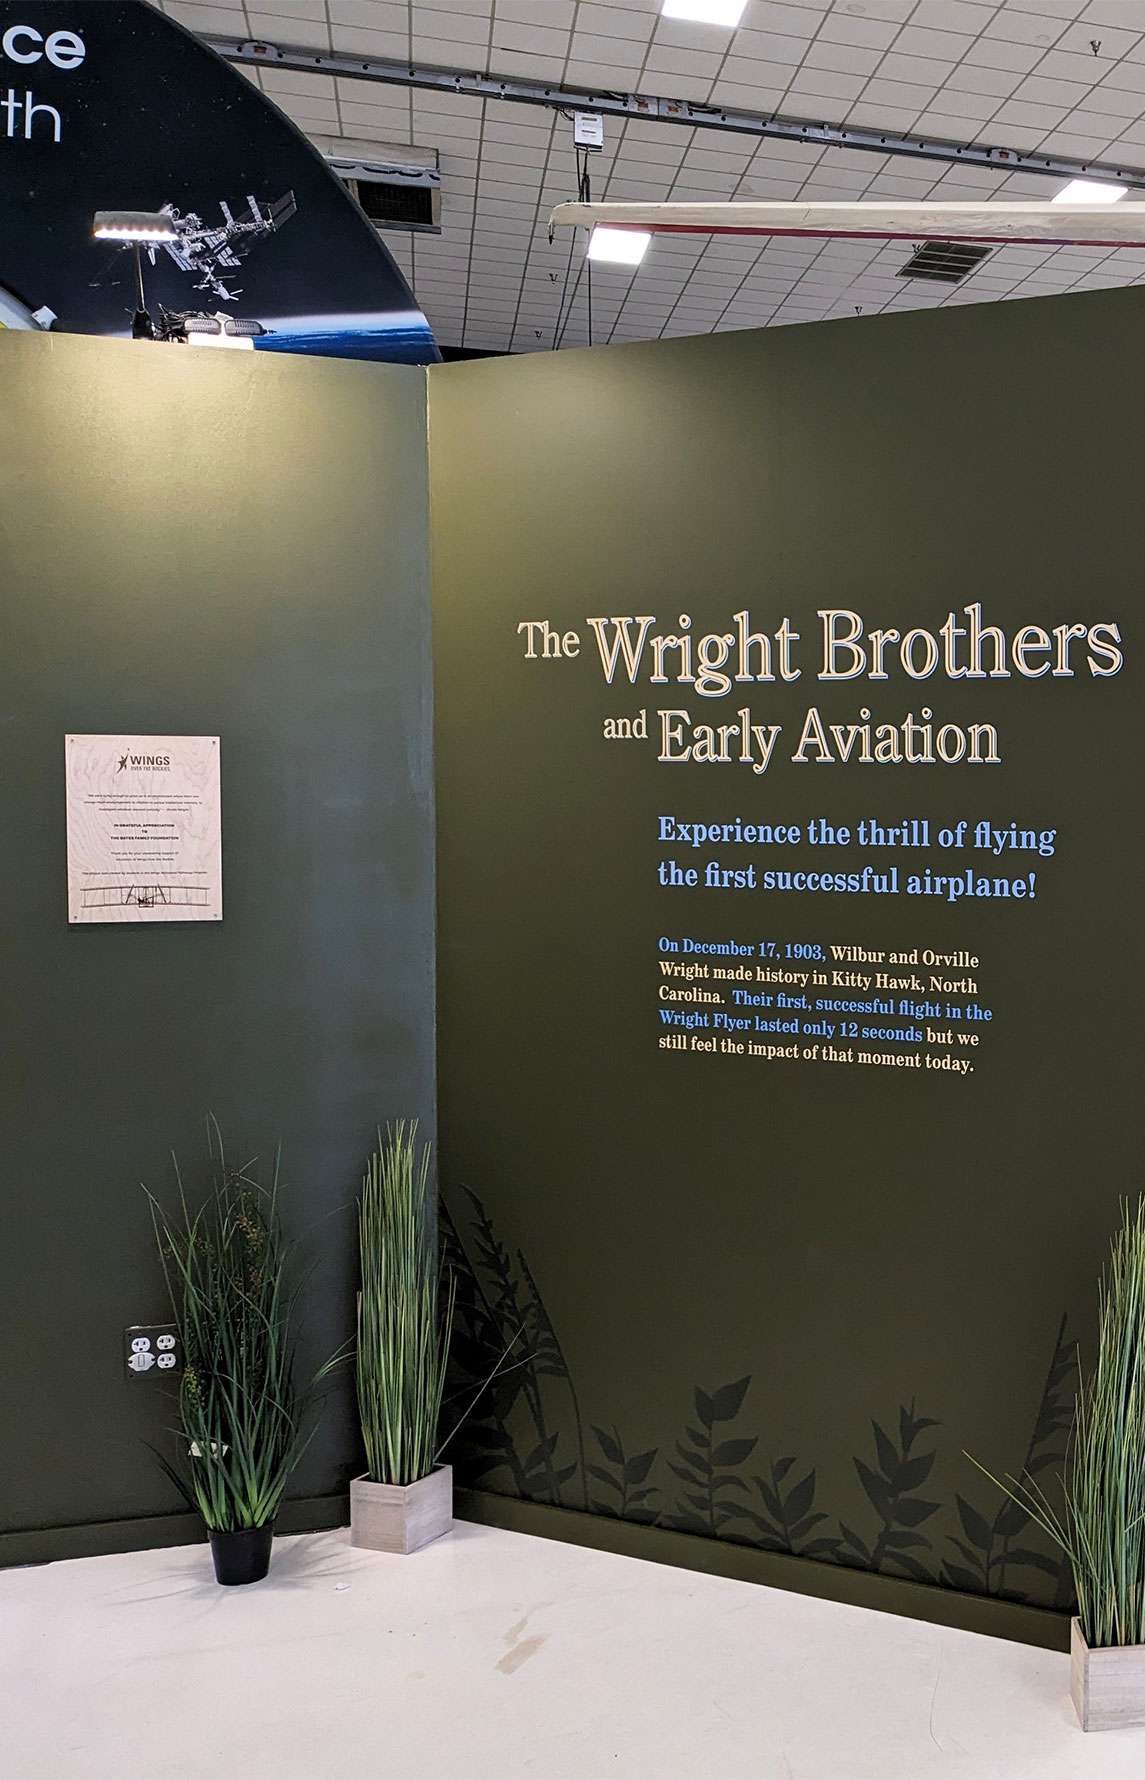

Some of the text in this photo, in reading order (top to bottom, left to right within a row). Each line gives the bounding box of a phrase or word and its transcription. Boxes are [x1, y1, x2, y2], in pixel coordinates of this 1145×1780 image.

[517, 602, 1124, 698] The Wright Brothers
[603, 707, 1002, 775] and Early Aviation
[130, 756, 170, 766] WINGS
[659, 817, 1056, 856] Experience the thrill of flying
[658, 861, 1035, 901] the first successful airplane!
[659, 938, 978, 968] On December 17, 1903, Wilbur and Orville
[659, 962, 978, 993] Wright made history in Kitty Hawk, North
[659, 986, 992, 1020] Carolina. Their first, successful flight in the
[660, 1010, 979, 1046] Wright Flyer lasted only 12 seconds but we
[659, 1035, 973, 1074] still feel the impact of that moment today.
